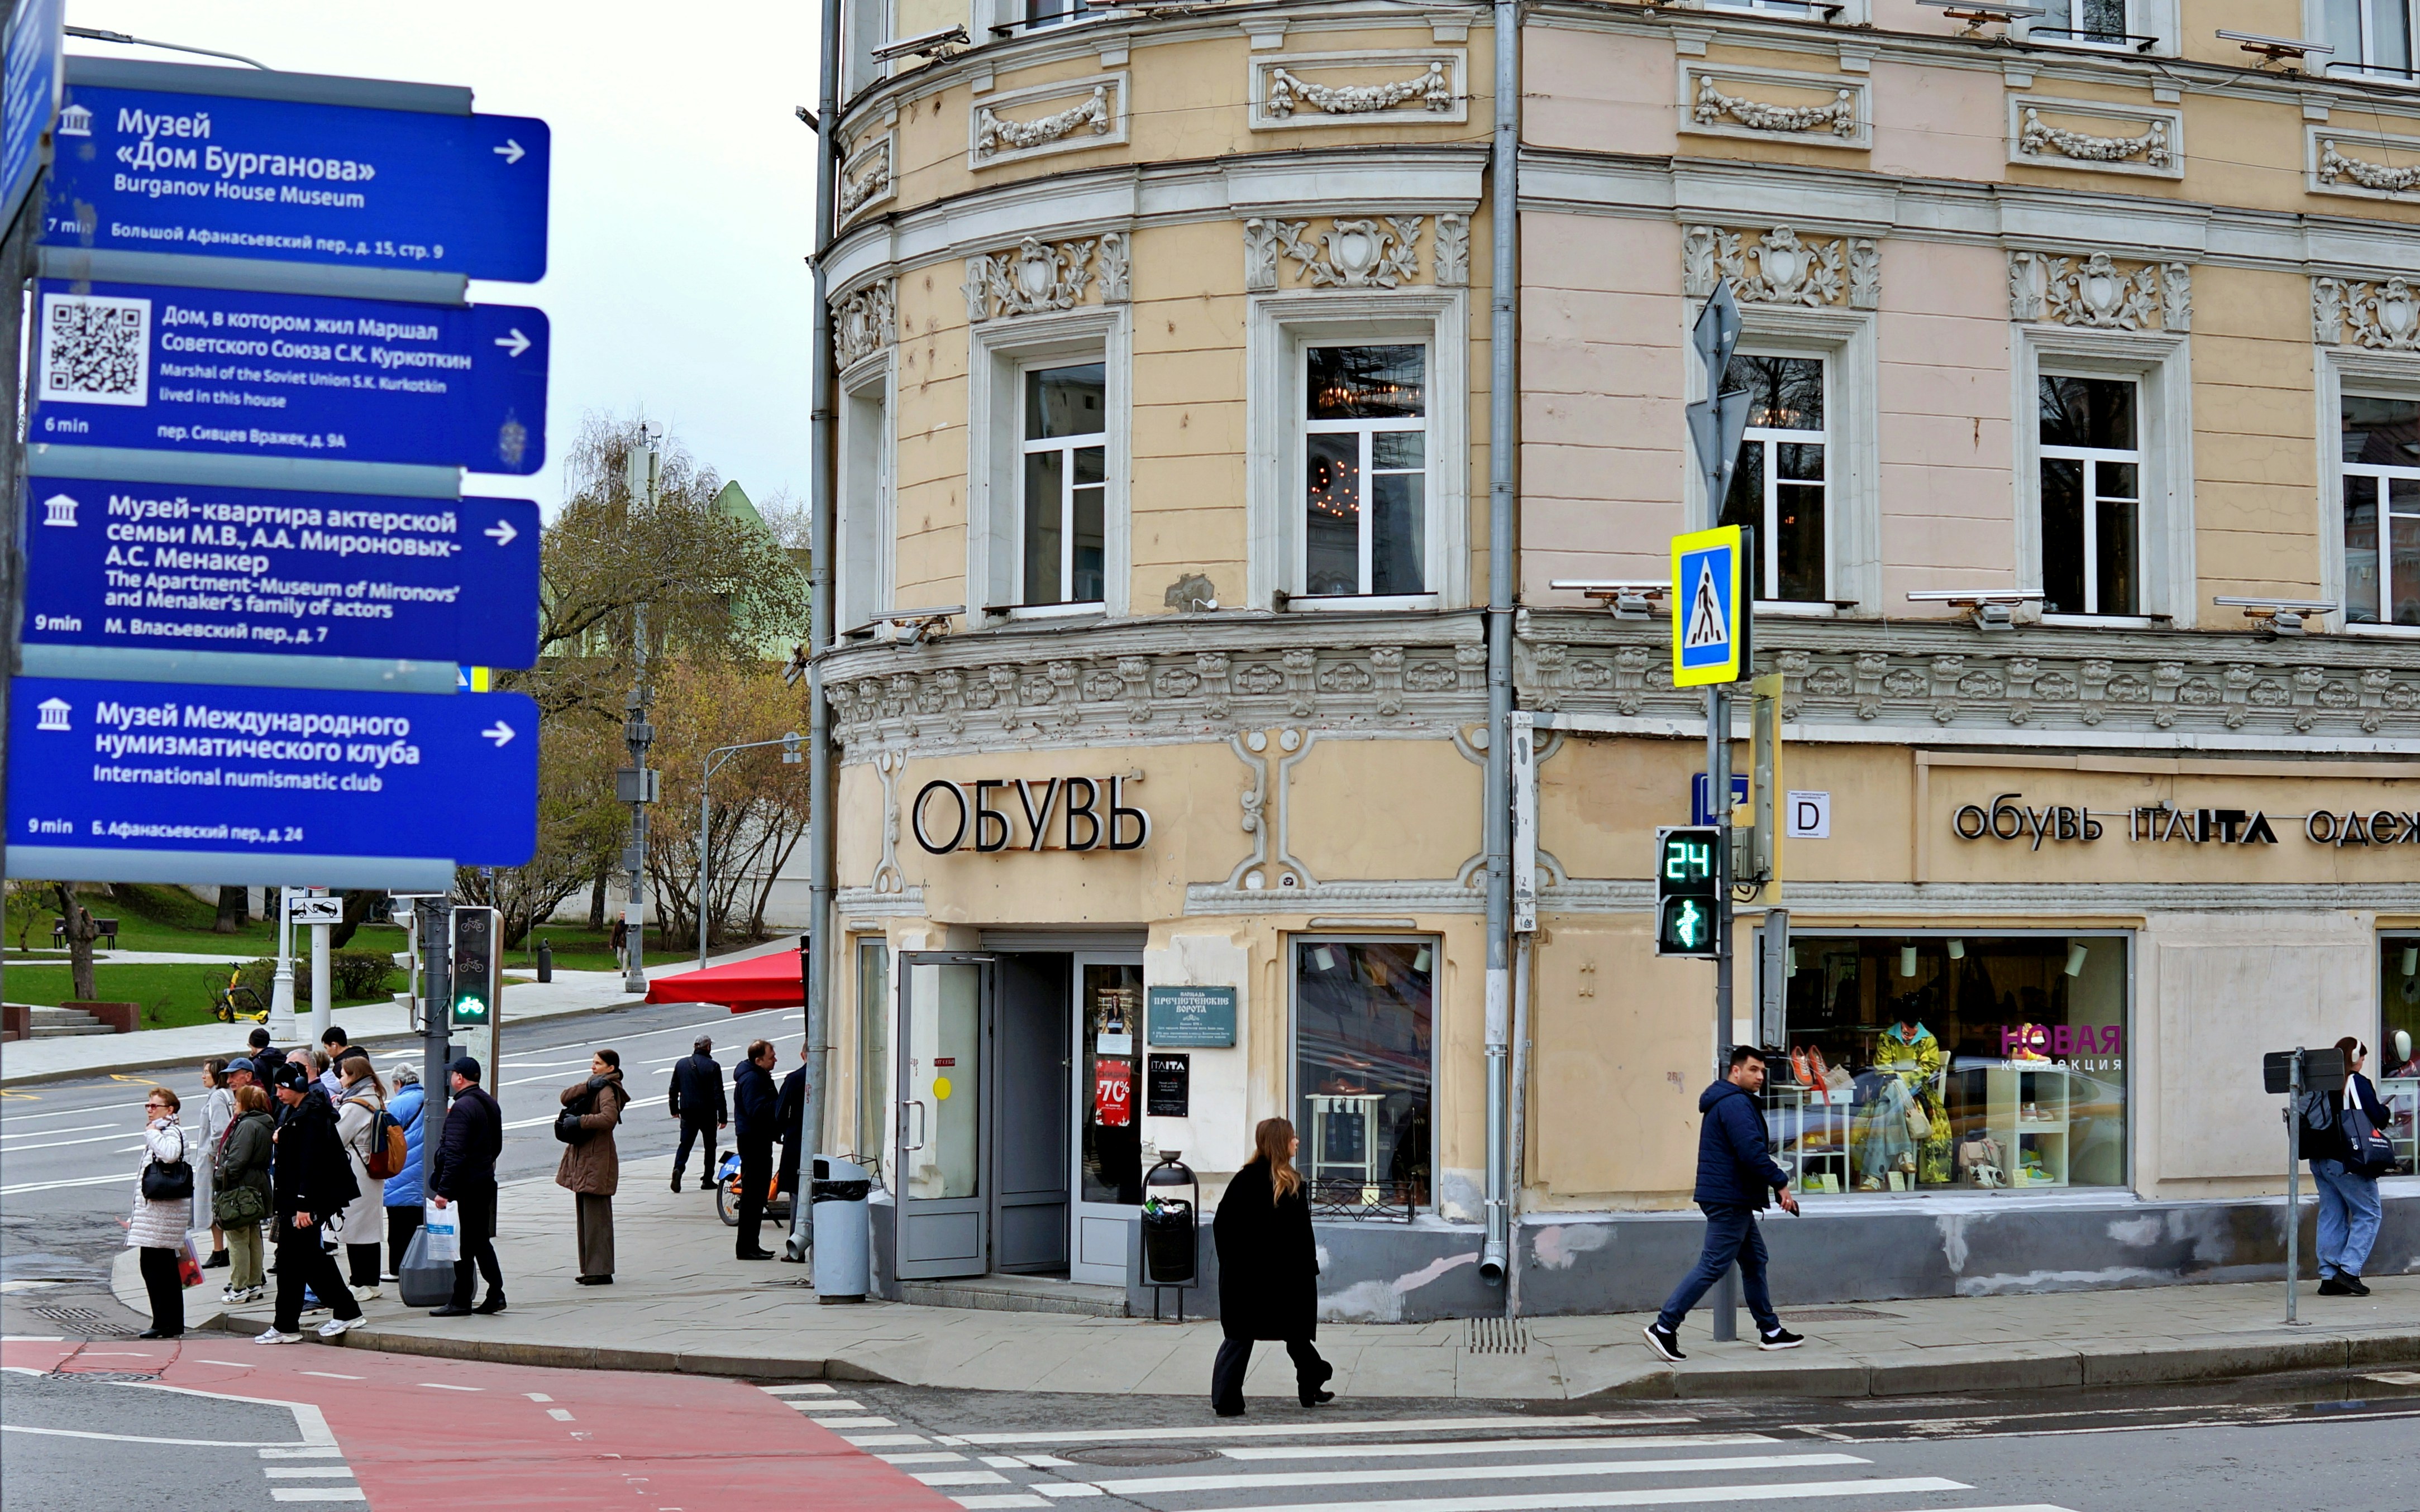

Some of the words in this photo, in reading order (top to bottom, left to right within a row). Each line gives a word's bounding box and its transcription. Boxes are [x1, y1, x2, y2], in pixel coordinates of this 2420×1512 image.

[118, 108, 210, 138] Музей
[116, 141, 197, 171] «Дом
[206, 146, 375, 181] Бурганова»
[114, 174, 209, 198] Burganov
[215, 181, 275, 202] House
[280, 186, 364, 208] Museum
[49, 219, 56, 230] 7
[112, 223, 183, 240] Большой
[188, 229, 312, 248] Афанасьевский
[434, 245, 443, 258] 9
[213, 312, 223, 326] в
[228, 314, 311, 333] котором
[314, 319, 354, 334] жил
[358, 319, 438, 341] Маршал
[162, 333, 268, 356] Советского
[271, 340, 331, 360] Союза
[371, 347, 471, 369] Куркоткин
[161, 364, 216, 378] Marshal
[219, 367, 235, 379] of
[237, 369, 261, 381] the
[264, 370, 306, 384] Soviet
[309, 374, 351, 386] Union
[379, 378, 446, 392] Kurkotkin
[160, 388, 193, 401] lived
[197, 391, 210, 402] in
[213, 392, 241, 405] this
[244, 394, 286, 408] house
[45, 418, 55, 431] 6
[58, 419, 88, 432] min
[192, 425, 247, 442] Сивцев
[327, 434, 346, 447] 9А
[108, 495, 322, 529] Музей-квартира
[327, 510, 456, 534] актерской
[107, 523, 185, 543] семьи
[300, 530, 461, 557] Мироновых-
[155, 548, 269, 577] Менакер
[106, 570, 141, 587] The
[145, 573, 342, 597] Apartment-Museum
[345, 581, 367, 597] of
[105, 590, 142, 606] and
[246, 595, 306, 618] family
[309, 598, 331, 615] of
[332, 602, 393, 618] actors
[35, 615, 47, 630] 9
[48, 615, 82, 631] min
[131, 619, 248, 638] Власьевский
[317, 627, 328, 642] 7
[96, 702, 178, 731] Музей
[184, 704, 409, 738] Международного
[96, 734, 341, 763] нумизматического
[347, 740, 419, 769] клуба
[94, 765, 221, 785] International
[225, 771, 337, 790] numismatic
[341, 773, 382, 792] club
[29, 819, 39, 832] 9
[41, 820, 73, 833] min
[913, 776, 1151, 855] ОБУВЬ
[1798, 802, 1819, 830] D
[108, 822, 228, 839] Афанасьевский
[284, 827, 303, 841] 24
[1665, 842, 1709, 879] 24
[1176, 1005, 1206, 1013] ВОРОТА
[2001, 1025, 2122, 1055] НОВАЯ
